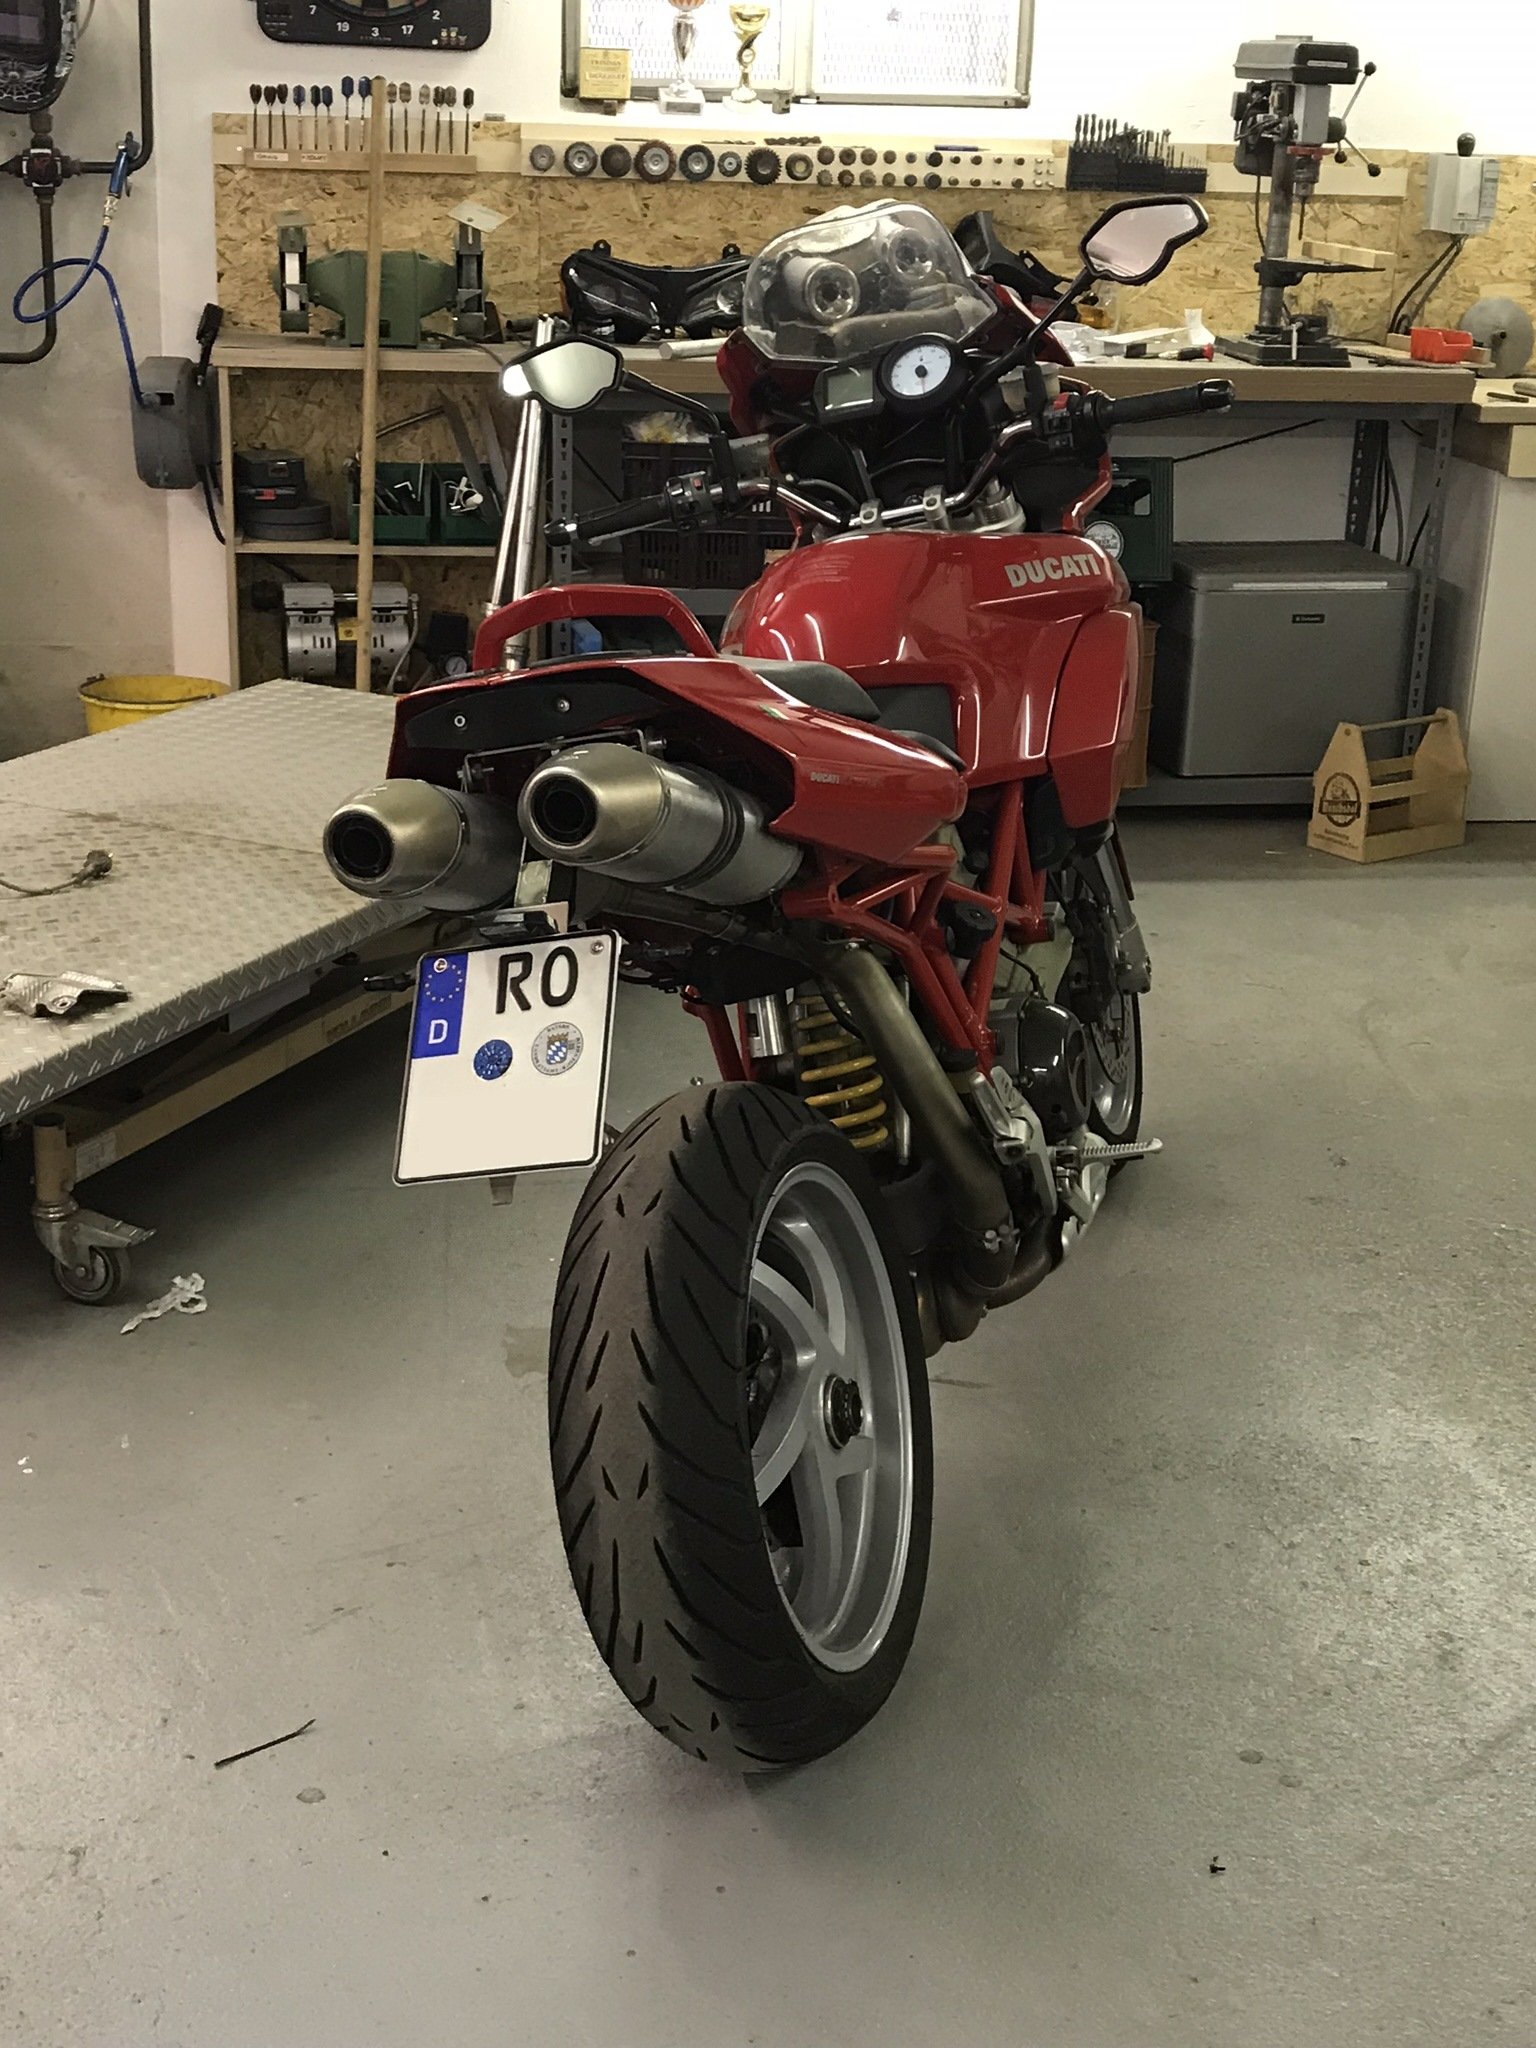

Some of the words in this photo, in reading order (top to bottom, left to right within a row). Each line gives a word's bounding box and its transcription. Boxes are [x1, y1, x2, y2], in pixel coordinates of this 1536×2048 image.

[309, 5, 317, 15] 7
[432, 10, 440, 21] 2
[336, 21, 350, 32] 19
[371, 27, 380, 37] 3
[401, 25, 414, 35] 17
[1004, 553, 1101, 588] DUCATI
[810, 771, 840, 785] DUCATI
[496, 945, 578, 1015] RO
[428, 1019, 448, 1044] D
